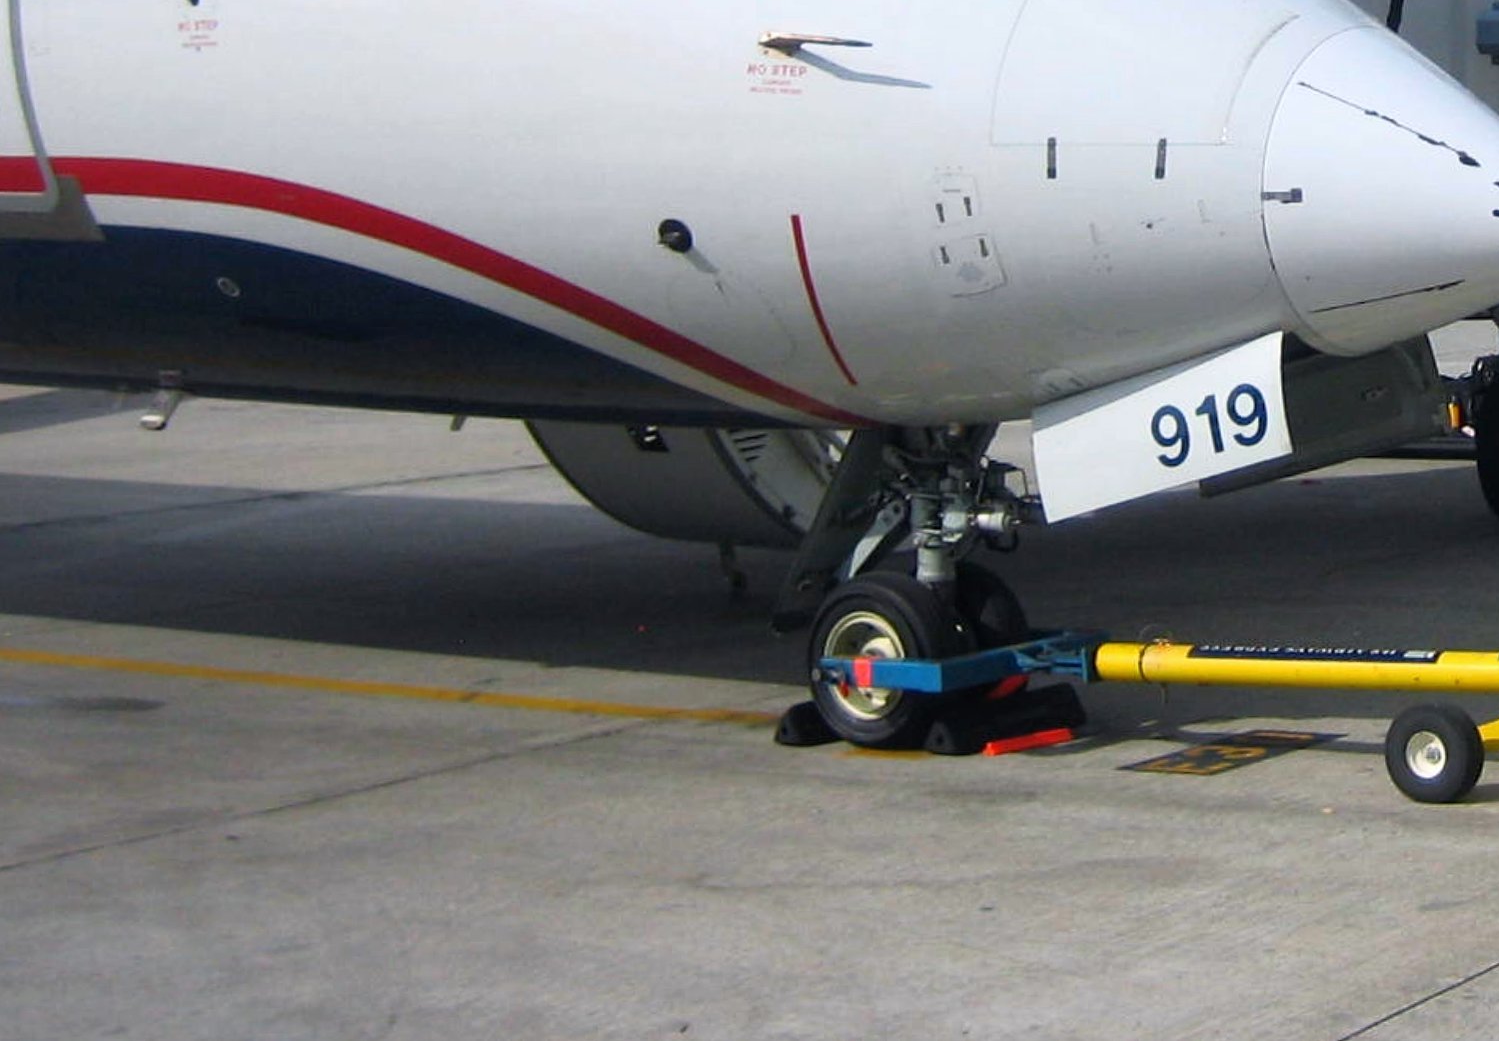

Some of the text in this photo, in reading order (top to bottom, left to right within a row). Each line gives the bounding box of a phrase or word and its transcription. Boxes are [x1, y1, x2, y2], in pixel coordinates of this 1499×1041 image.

[747, 63, 808, 77] NO STEP
[1151, 383, 1269, 468] 919
